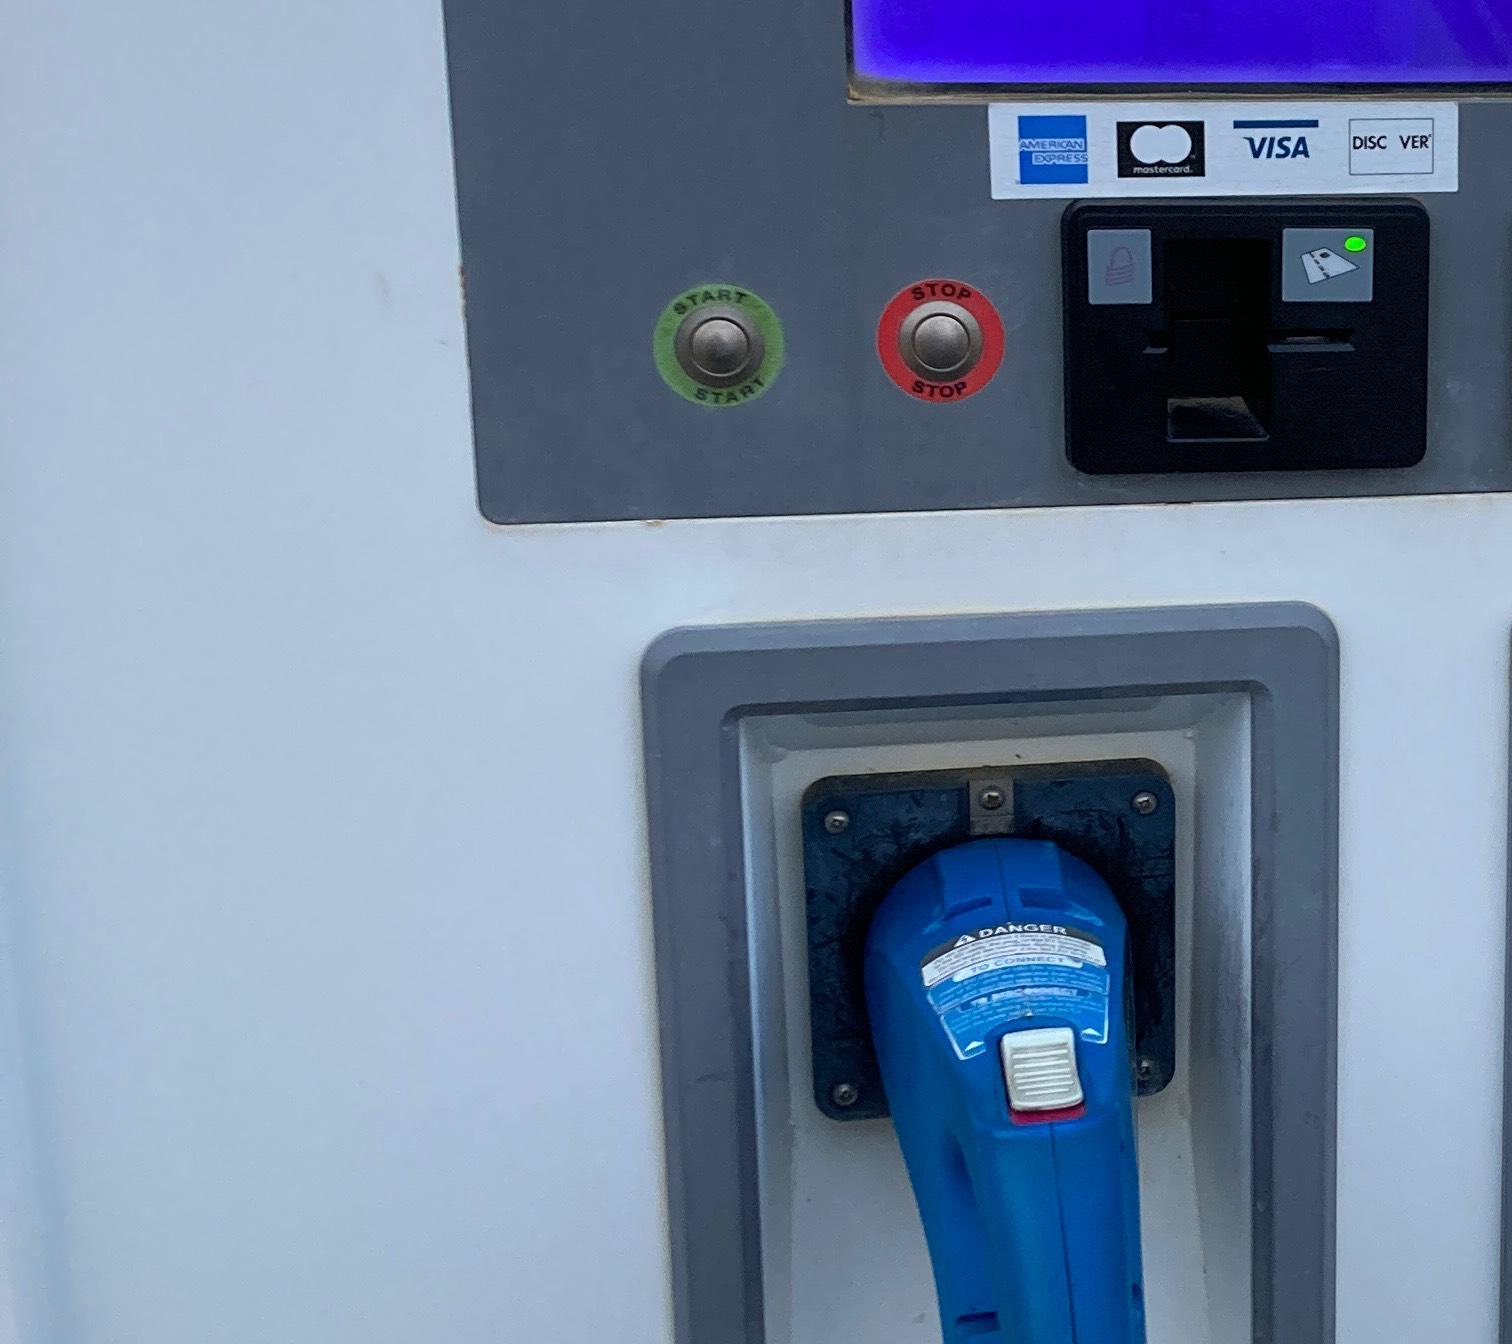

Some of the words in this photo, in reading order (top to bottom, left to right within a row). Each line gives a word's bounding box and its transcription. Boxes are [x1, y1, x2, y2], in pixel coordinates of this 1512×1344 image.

[1020, 138, 1084, 151] AMERICAN
[1242, 135, 1310, 159] VISA
[1034, 152, 1088, 165] EXPRESS
[1133, 164, 1191, 175] mastercard
[674, 288, 748, 315] START
[911, 283, 972, 302] STOP
[694, 377, 765, 404] START
[911, 379, 967, 399] STOP
[979, 923, 1068, 939] DANGER
[970, 962, 990, 974] TO
[992, 955, 1066, 969] CONNECT
